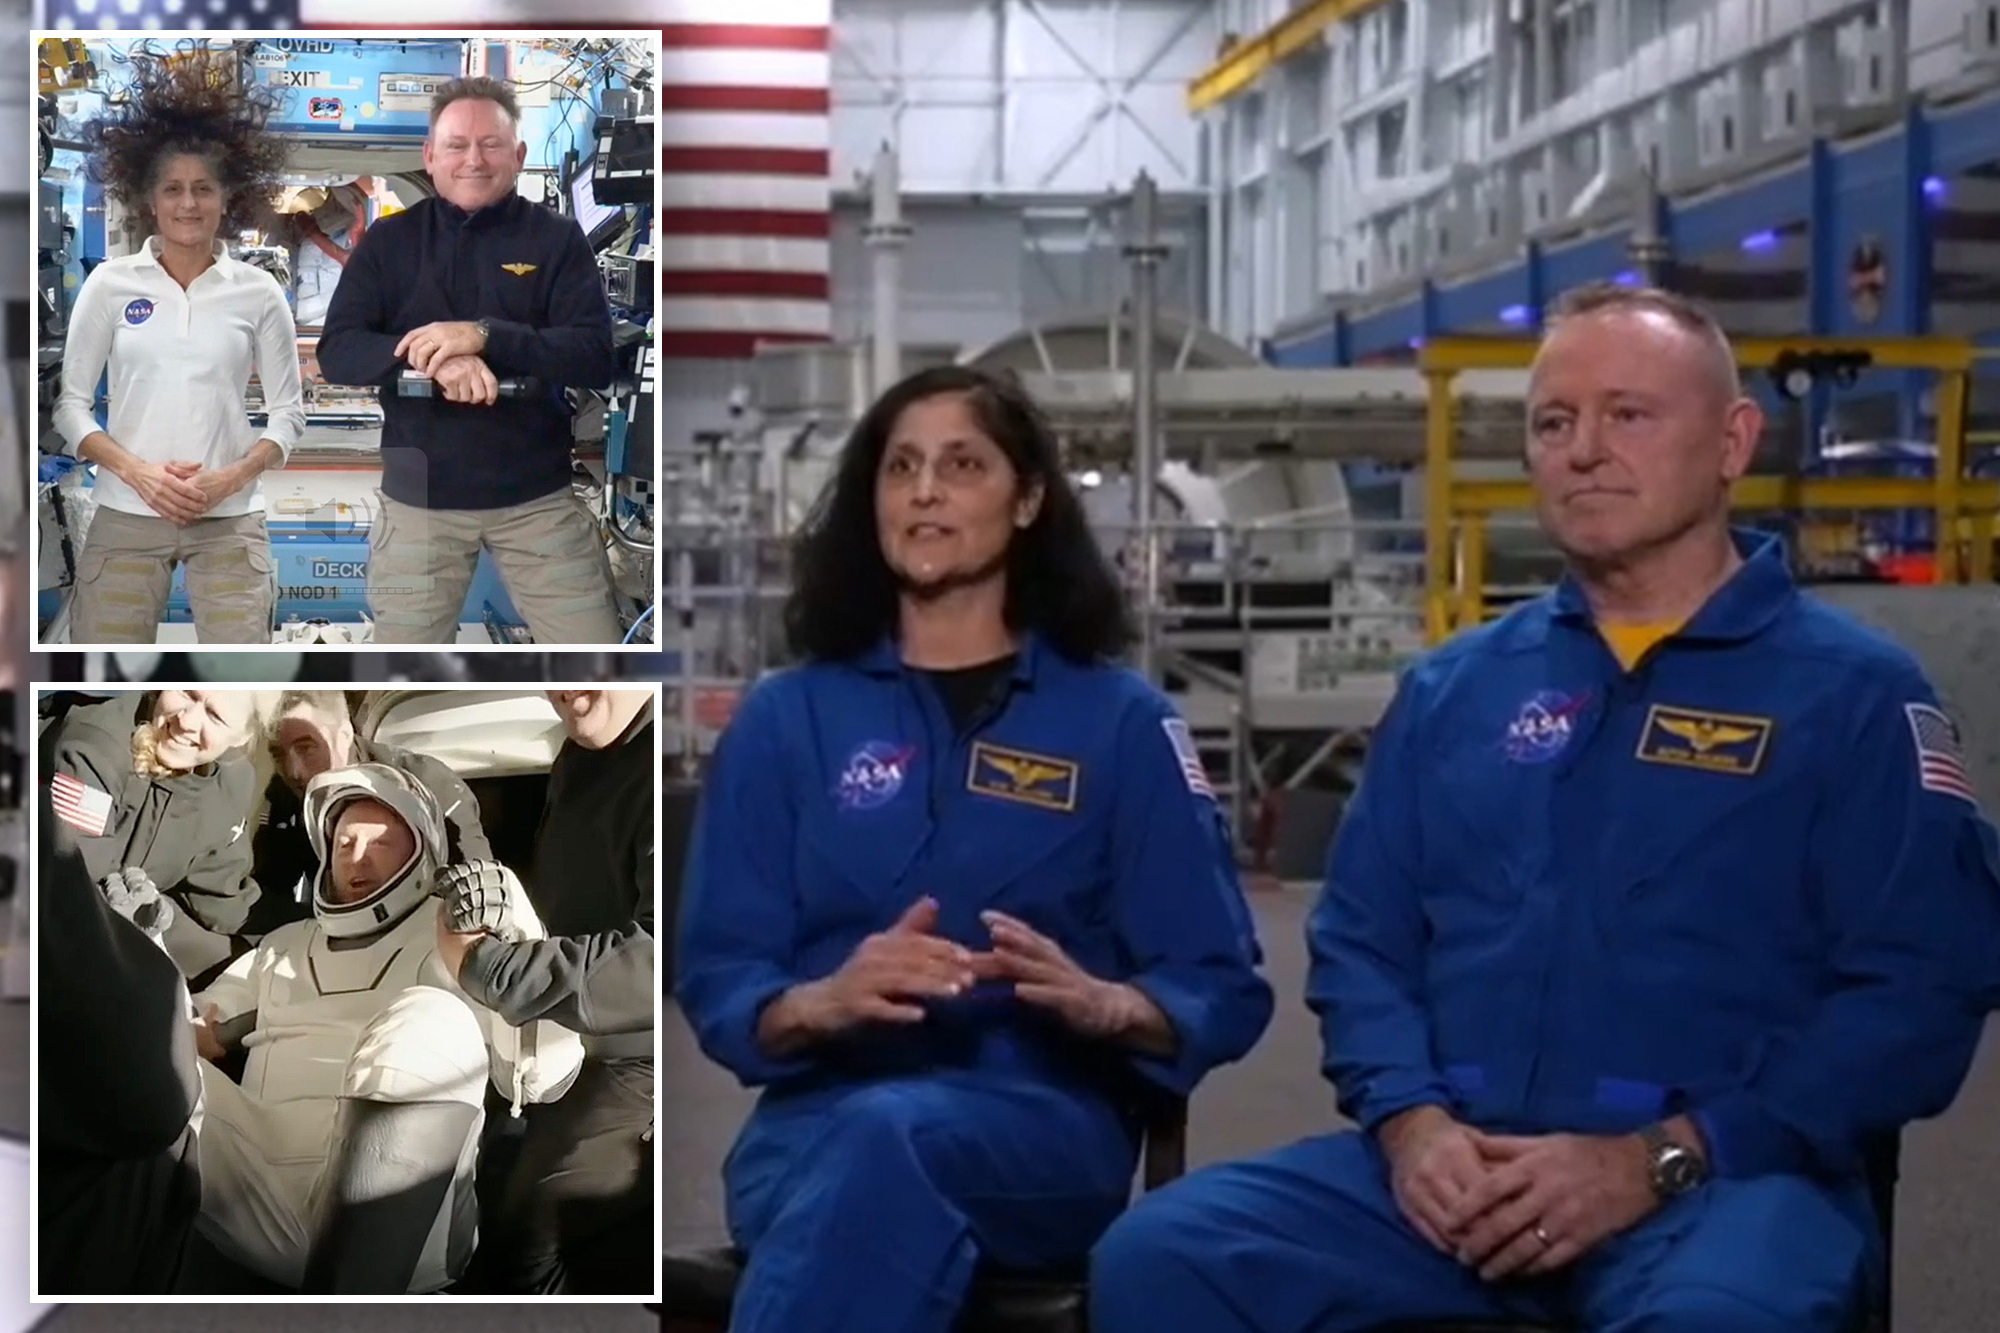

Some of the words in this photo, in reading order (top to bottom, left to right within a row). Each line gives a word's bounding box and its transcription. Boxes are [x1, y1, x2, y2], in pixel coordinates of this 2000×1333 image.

[279, 39, 333, 53] OVHD
[280, 71, 320, 86] EXIT
[127, 308, 151, 316] NASA
[314, 562, 365, 577] DECK
[289, 586, 325, 600] NOD
[330, 586, 337, 600] 1
[1508, 715, 1570, 739] NASA
[841, 763, 902, 787] NASA
